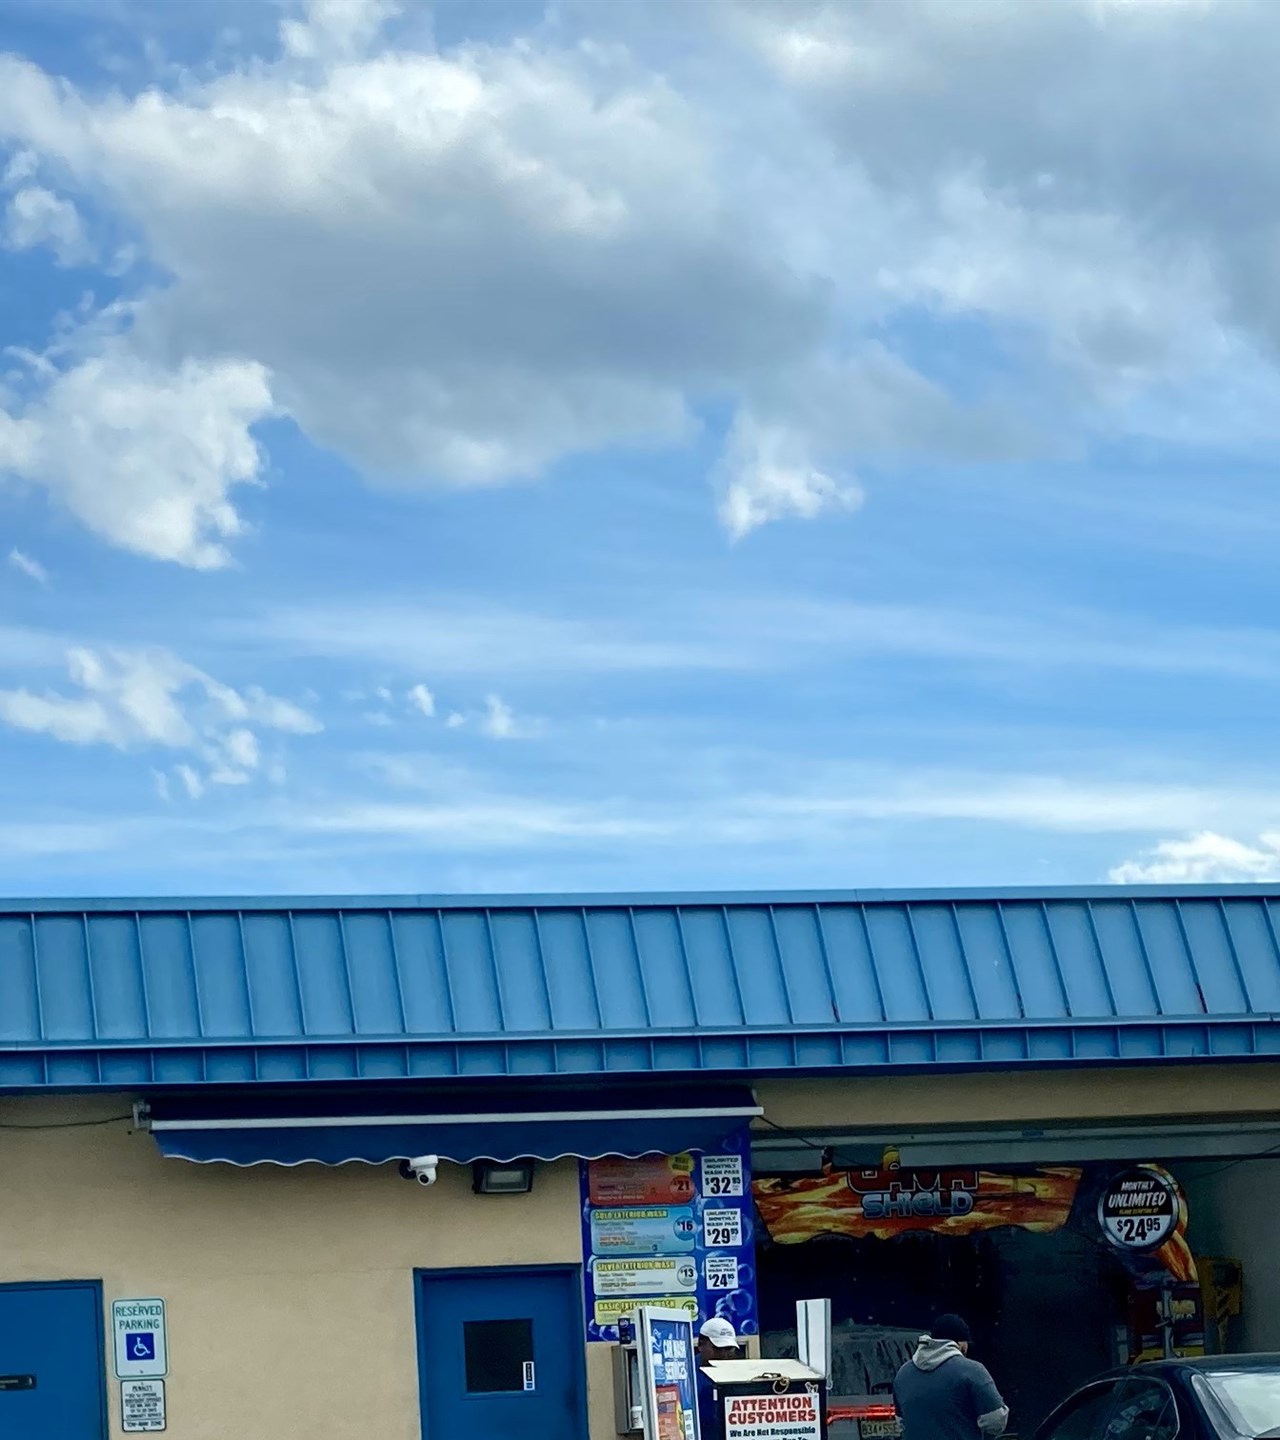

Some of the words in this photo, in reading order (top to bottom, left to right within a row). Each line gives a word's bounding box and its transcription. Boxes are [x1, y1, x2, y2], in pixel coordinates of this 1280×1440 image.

[1121, 1181, 1155, 1191] MONTHLY
[1108, 1191, 1167, 1208] UNLIMITED
[115, 1305, 162, 1317] RESERVED
[119, 1319, 160, 1330] PARKING
[732, 1396, 812, 1411] ATTENTION
[728, 1410, 816, 1425] CUSTOMERS
[743, 1429, 756, 1437] Are
[771, 1426, 816, 1436] Responsible
